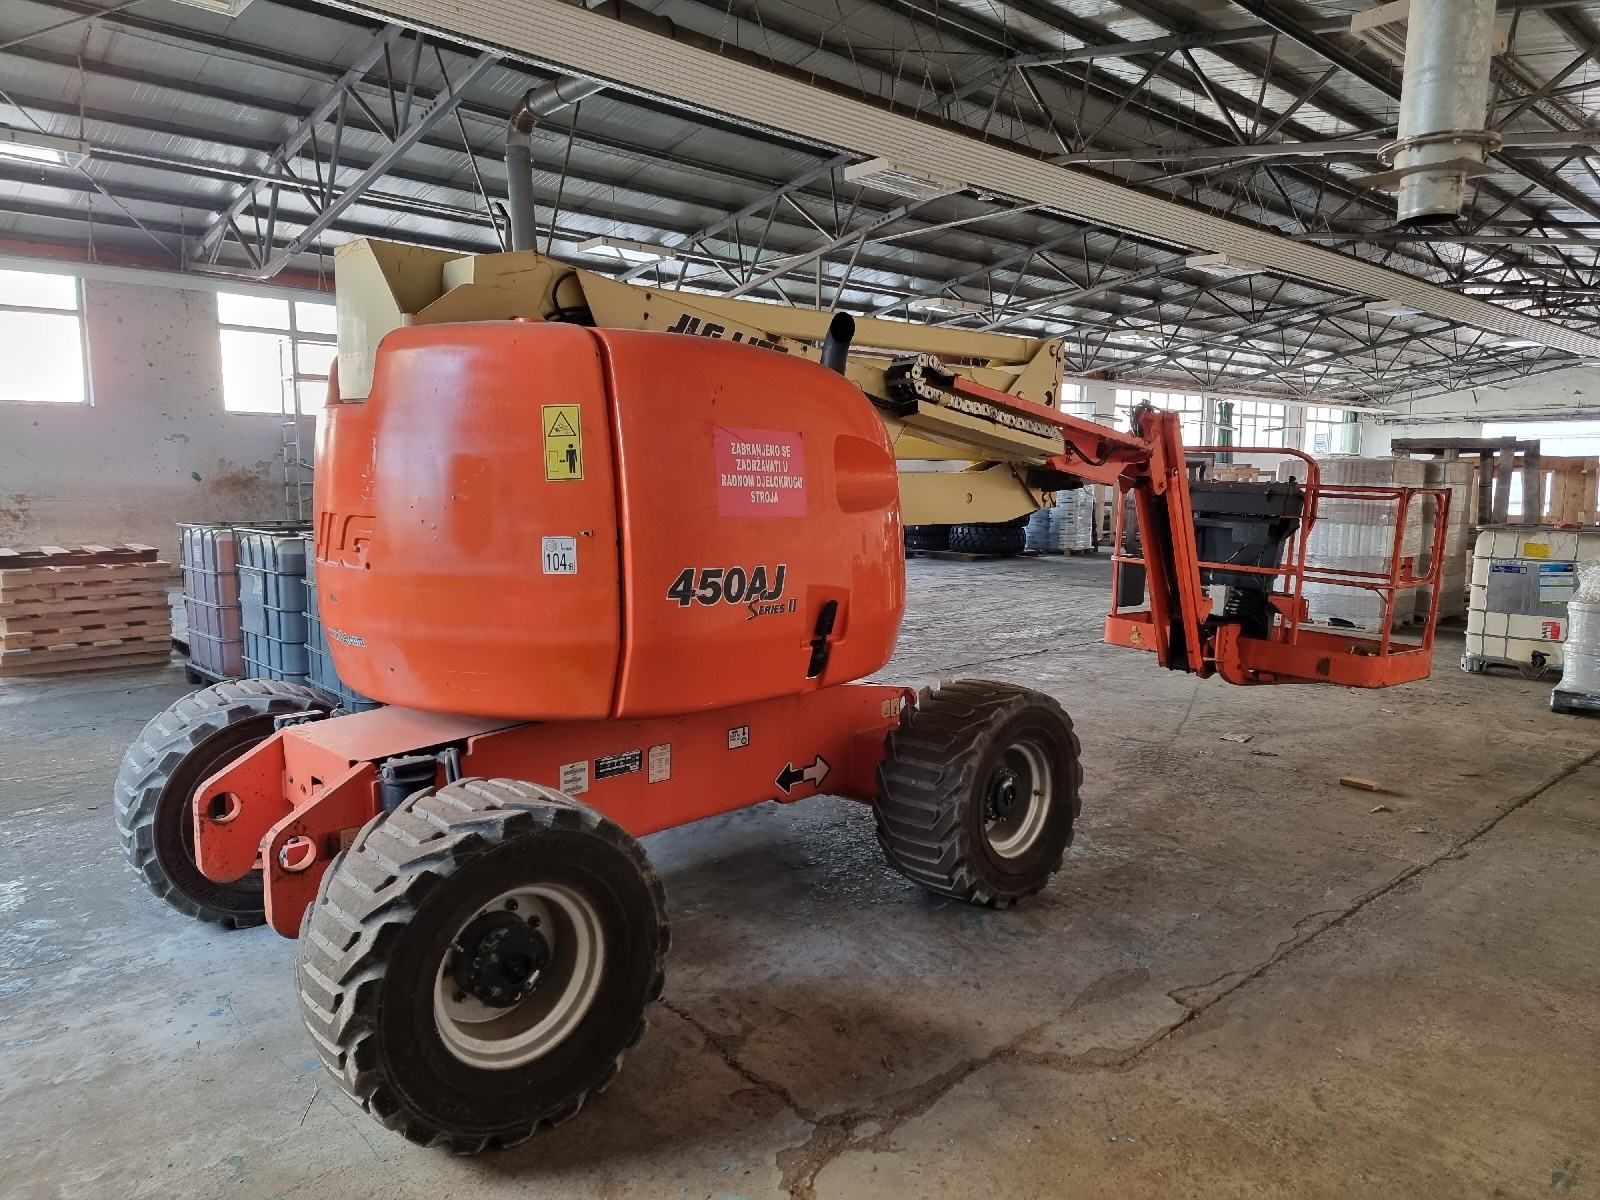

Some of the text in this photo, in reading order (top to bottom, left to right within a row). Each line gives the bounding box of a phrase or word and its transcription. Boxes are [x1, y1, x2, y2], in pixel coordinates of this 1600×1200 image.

[731, 442, 791, 457] ZABRANJENO SE
[782, 460, 788, 472] U
[721, 474, 803, 488] RADNOM DJELOKRUGU
[750, 490, 779, 504] STROJA
[546, 553, 567, 571] 104
[666, 564, 787, 608] 450AJ
